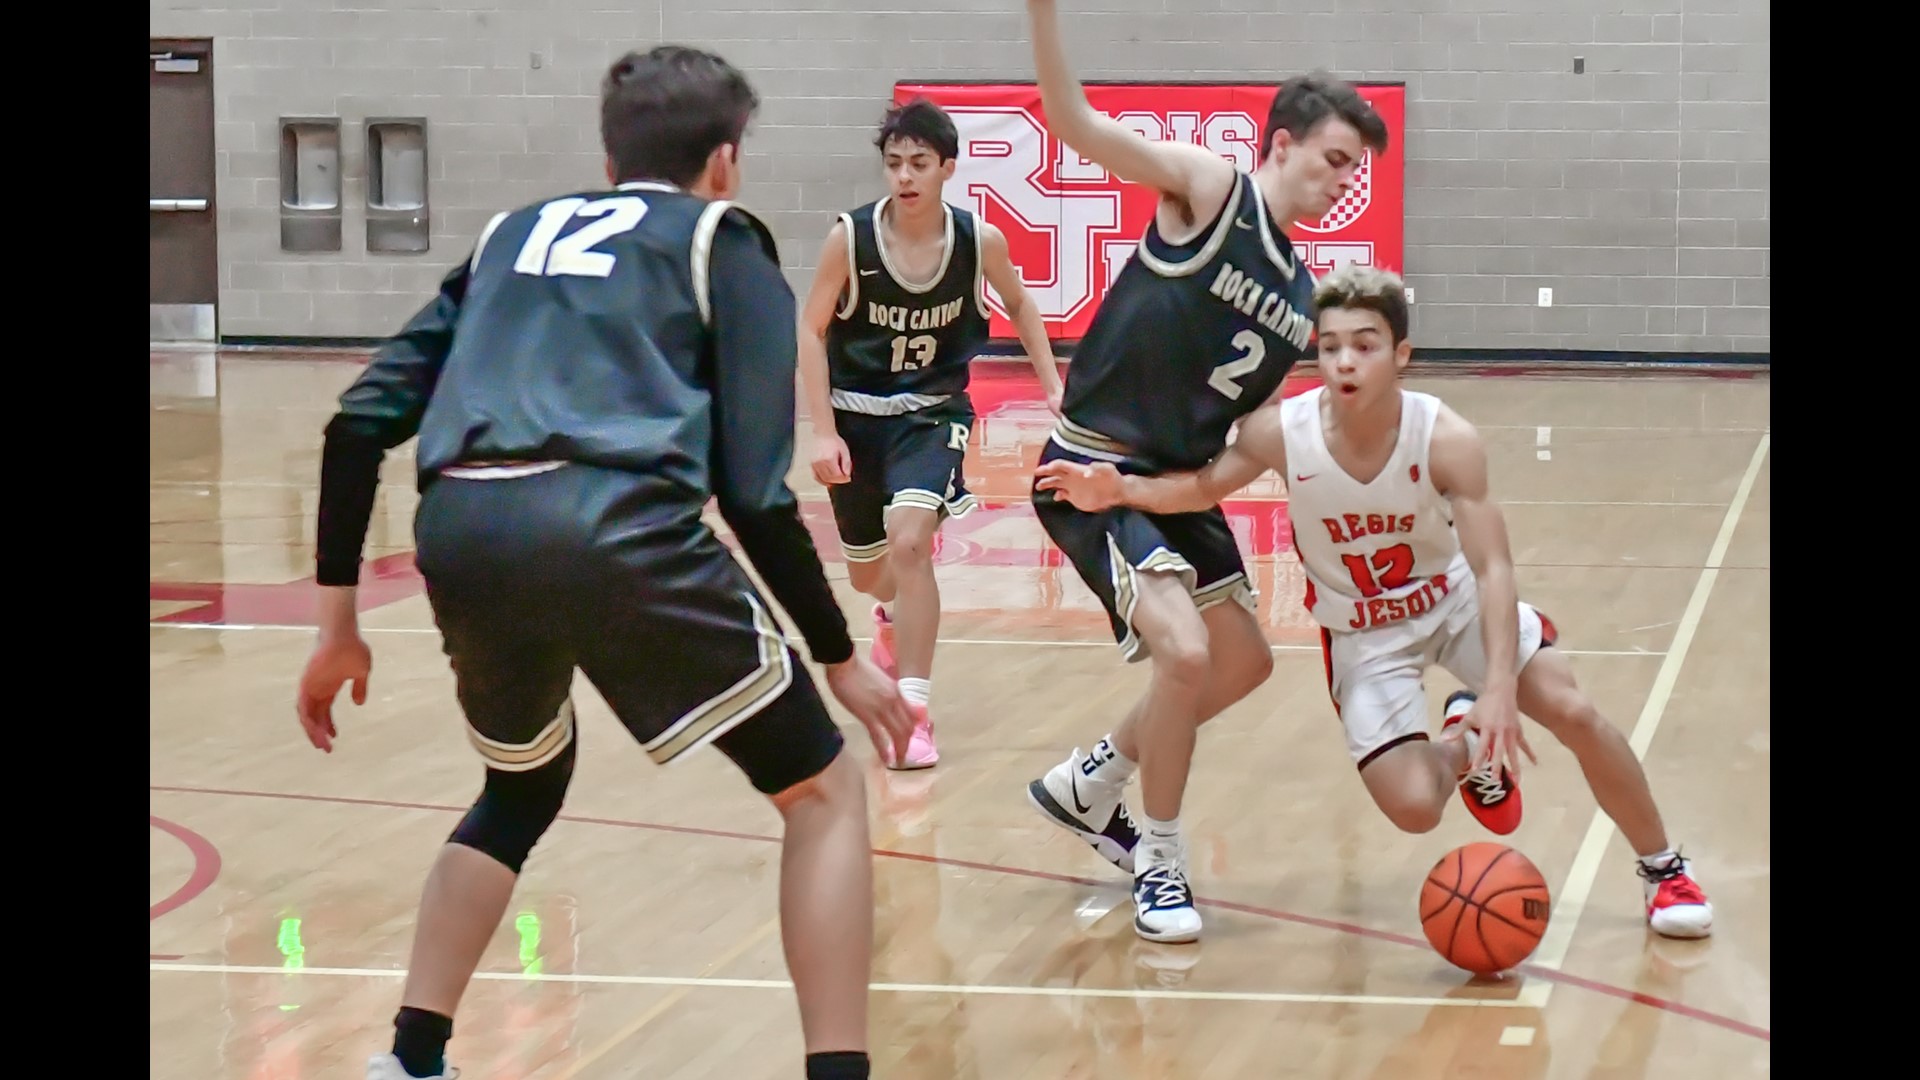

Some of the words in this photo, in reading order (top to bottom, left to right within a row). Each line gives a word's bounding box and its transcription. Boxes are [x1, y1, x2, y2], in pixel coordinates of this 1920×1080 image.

[513, 196, 649, 278] 12
[869, 301, 908, 332] ROCK
[910, 296, 963, 330] CANYON
[1209, 261, 1264, 316] ROCK
[890, 334, 938, 373] 13
[1207, 329, 1266, 401] 2
[947, 421, 970, 452] R
[1322, 513, 1416, 544] REGIS
[1341, 543, 1416, 598] 12
[1349, 574, 1449, 629] JESUIT
